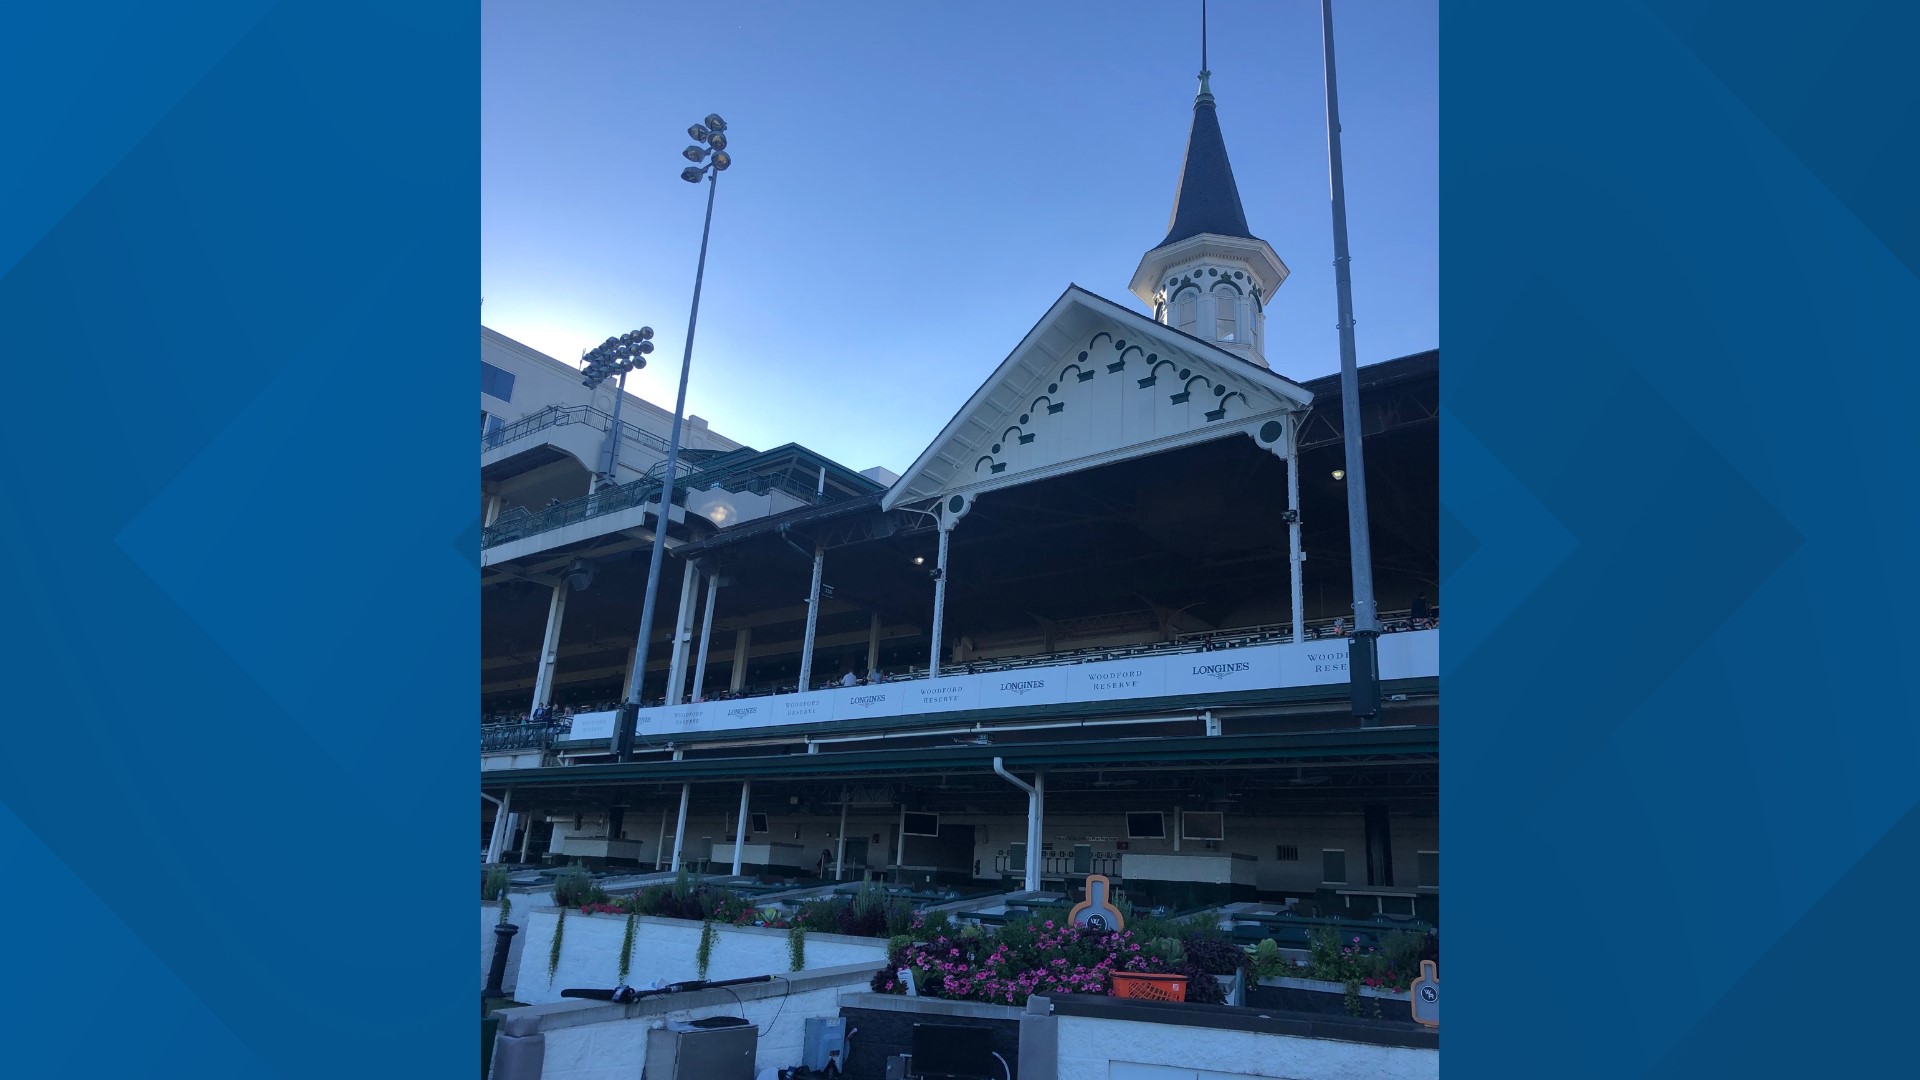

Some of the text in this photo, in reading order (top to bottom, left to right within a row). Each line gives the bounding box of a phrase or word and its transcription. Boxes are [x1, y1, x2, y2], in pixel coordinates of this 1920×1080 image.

[1192, 662, 1250, 675] LONGINES
[1315, 663, 1347, 673] RESE
[1088, 670, 1143, 681] WOODFORD
[1000, 680, 1045, 691] LONGINES
[1093, 681, 1138, 690] RESERVE
[920, 686, 963, 695] WOODFORD
[850, 694, 886, 705] LONGINES
[923, 695, 959, 704] RESERVE
[785, 700, 821, 709] WOODFORD
[727, 707, 757, 716] LONGINES
